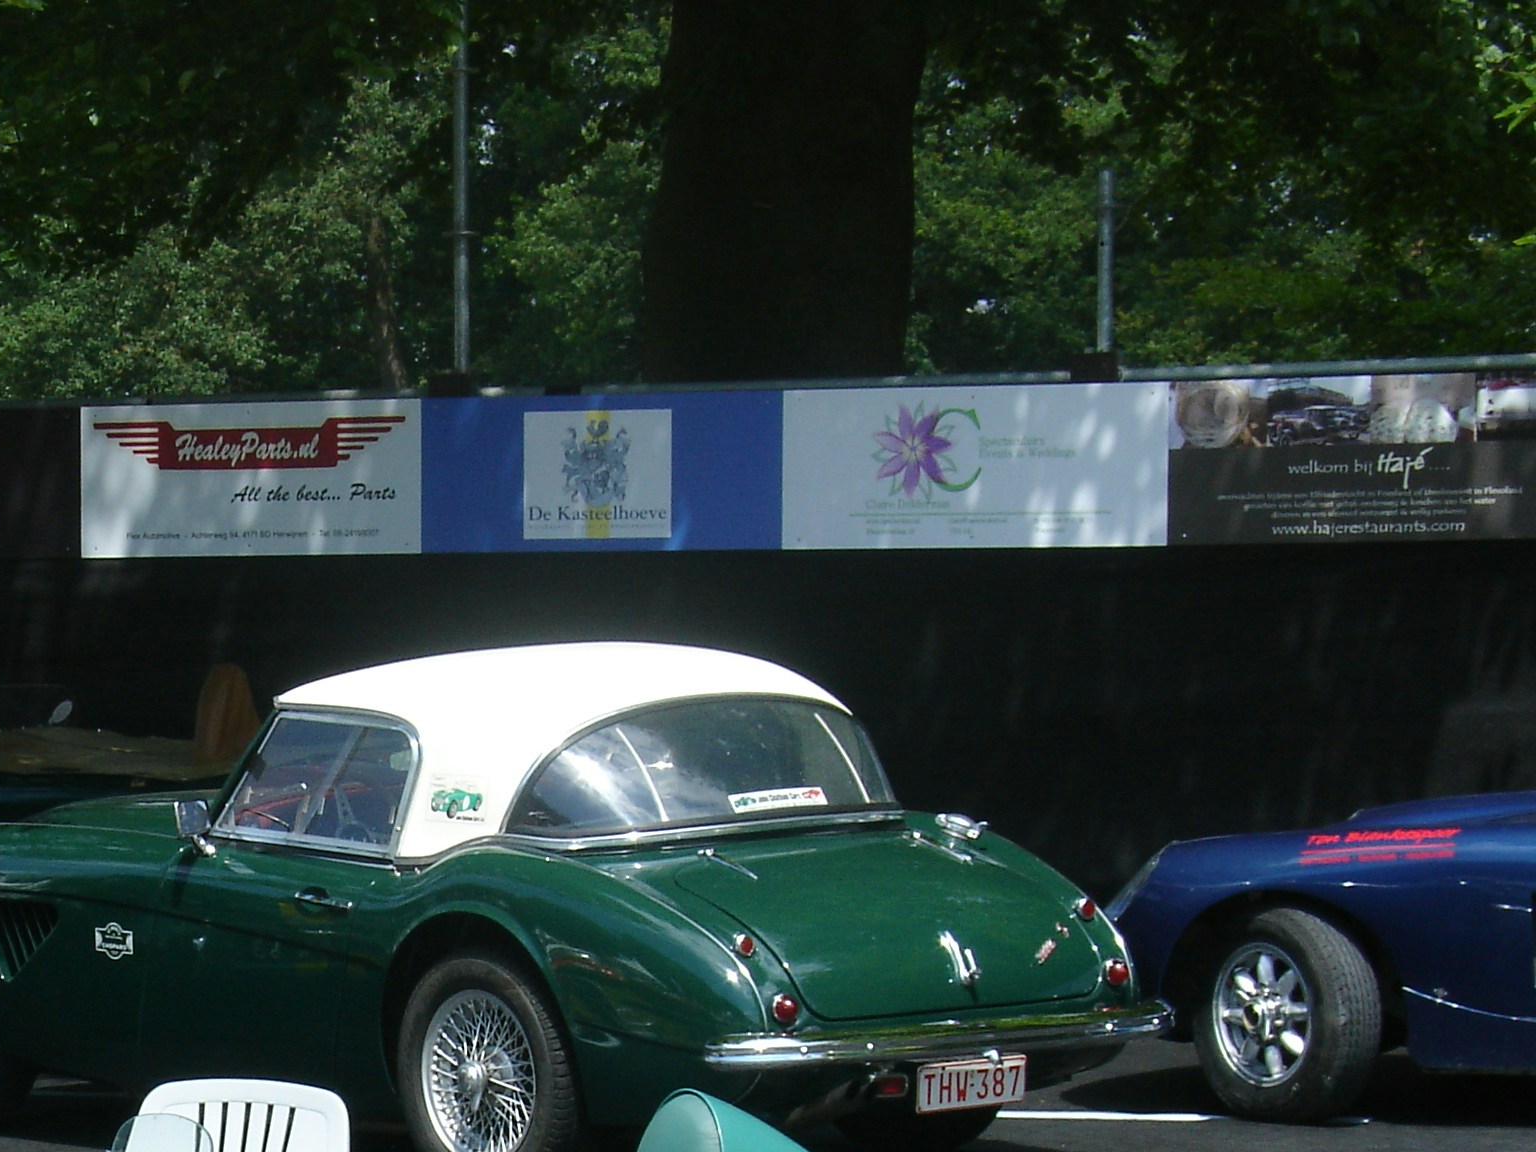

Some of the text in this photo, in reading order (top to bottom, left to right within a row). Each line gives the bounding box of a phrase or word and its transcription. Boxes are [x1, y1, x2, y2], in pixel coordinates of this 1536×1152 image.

[175, 431, 320, 467] HealeyParts.nl
[1288, 458, 1348, 475] welkom
[231, 485, 262, 503] All
[266, 485, 291, 502] the
[350, 483, 397, 501] Parts
[528, 505, 667, 522] De Kasteelhoeve
[1271, 519, 1466, 538] www.hajerestaurants.com
